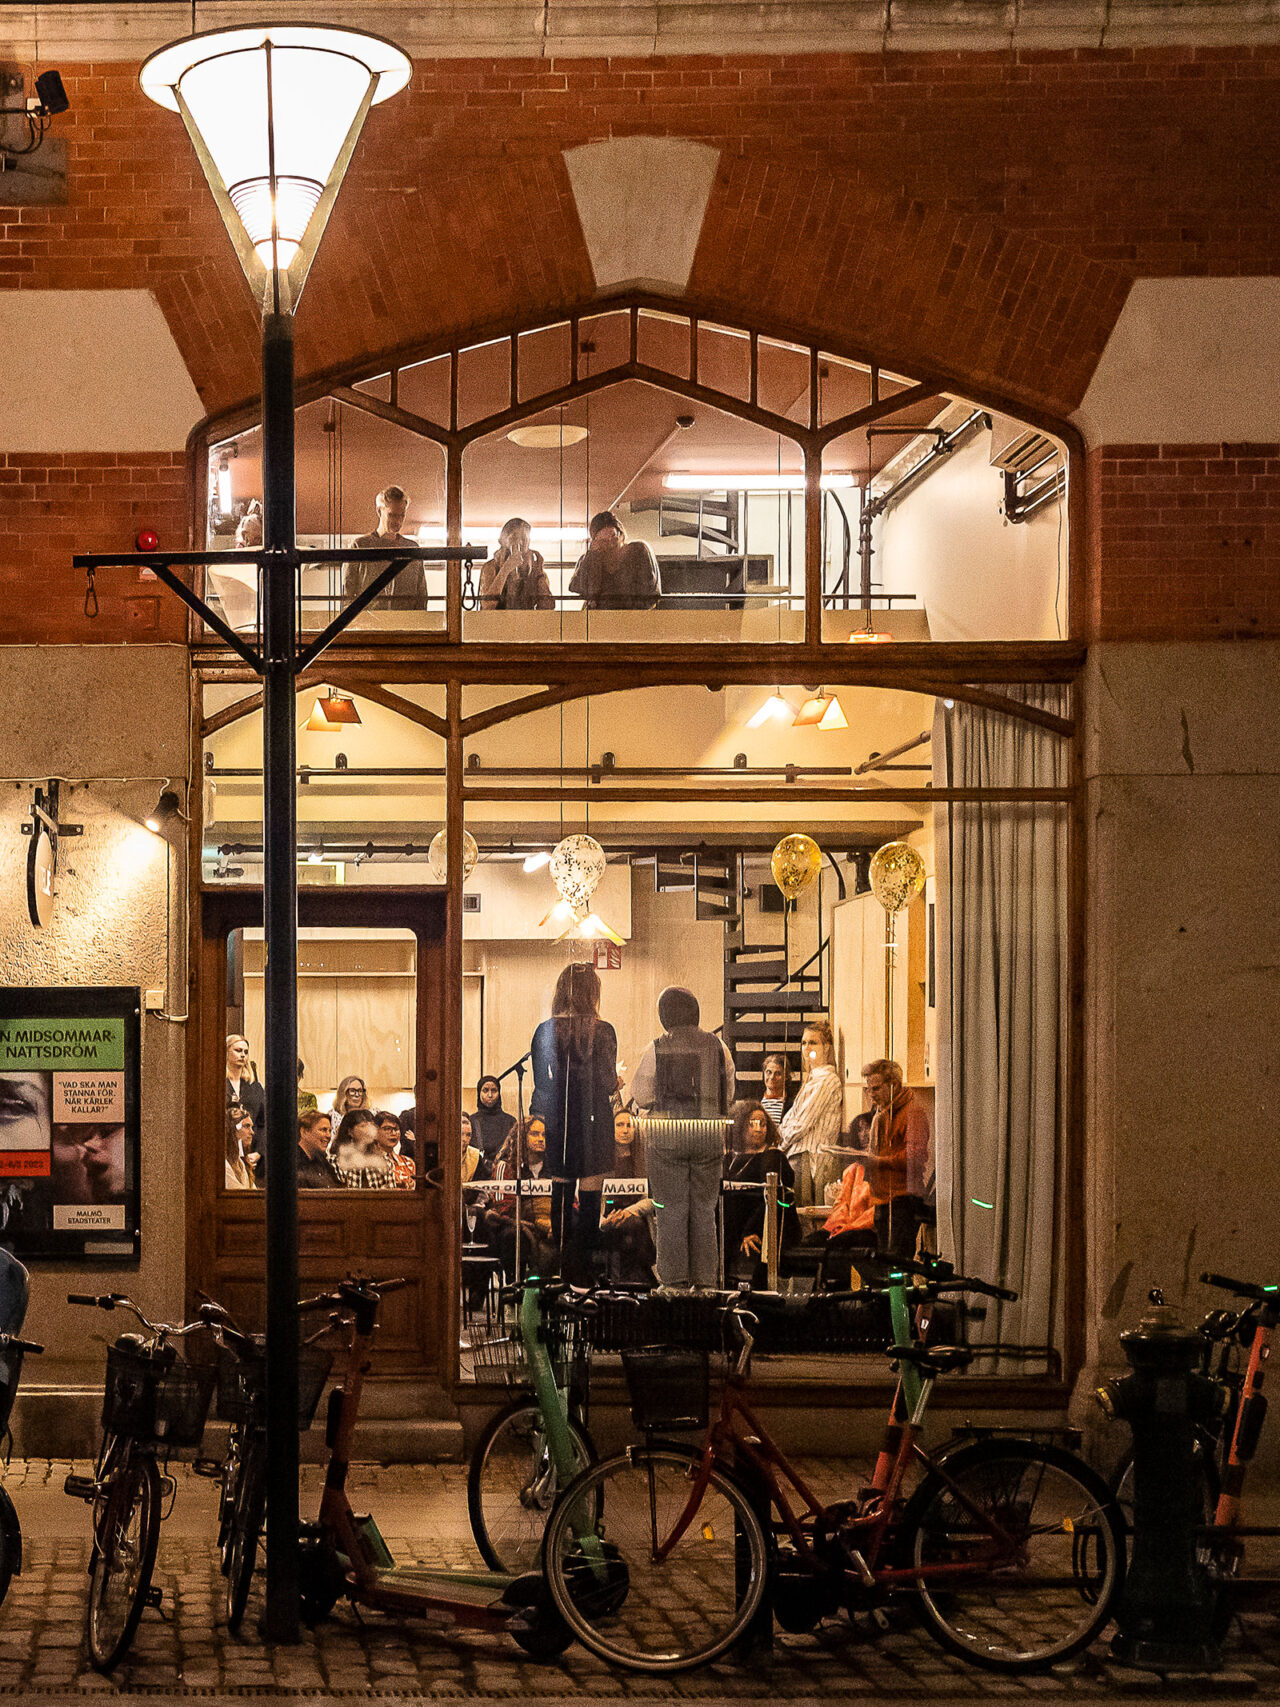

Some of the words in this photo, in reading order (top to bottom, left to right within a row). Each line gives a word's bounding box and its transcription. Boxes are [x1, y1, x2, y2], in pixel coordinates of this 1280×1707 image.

[15, 1030, 116, 1042] MIDSOMMAR-
[6, 1043, 97, 1058] NATTSDRÖM
[79, 1081, 96, 1089] SKA
[97, 1081, 118, 1089] MAN
